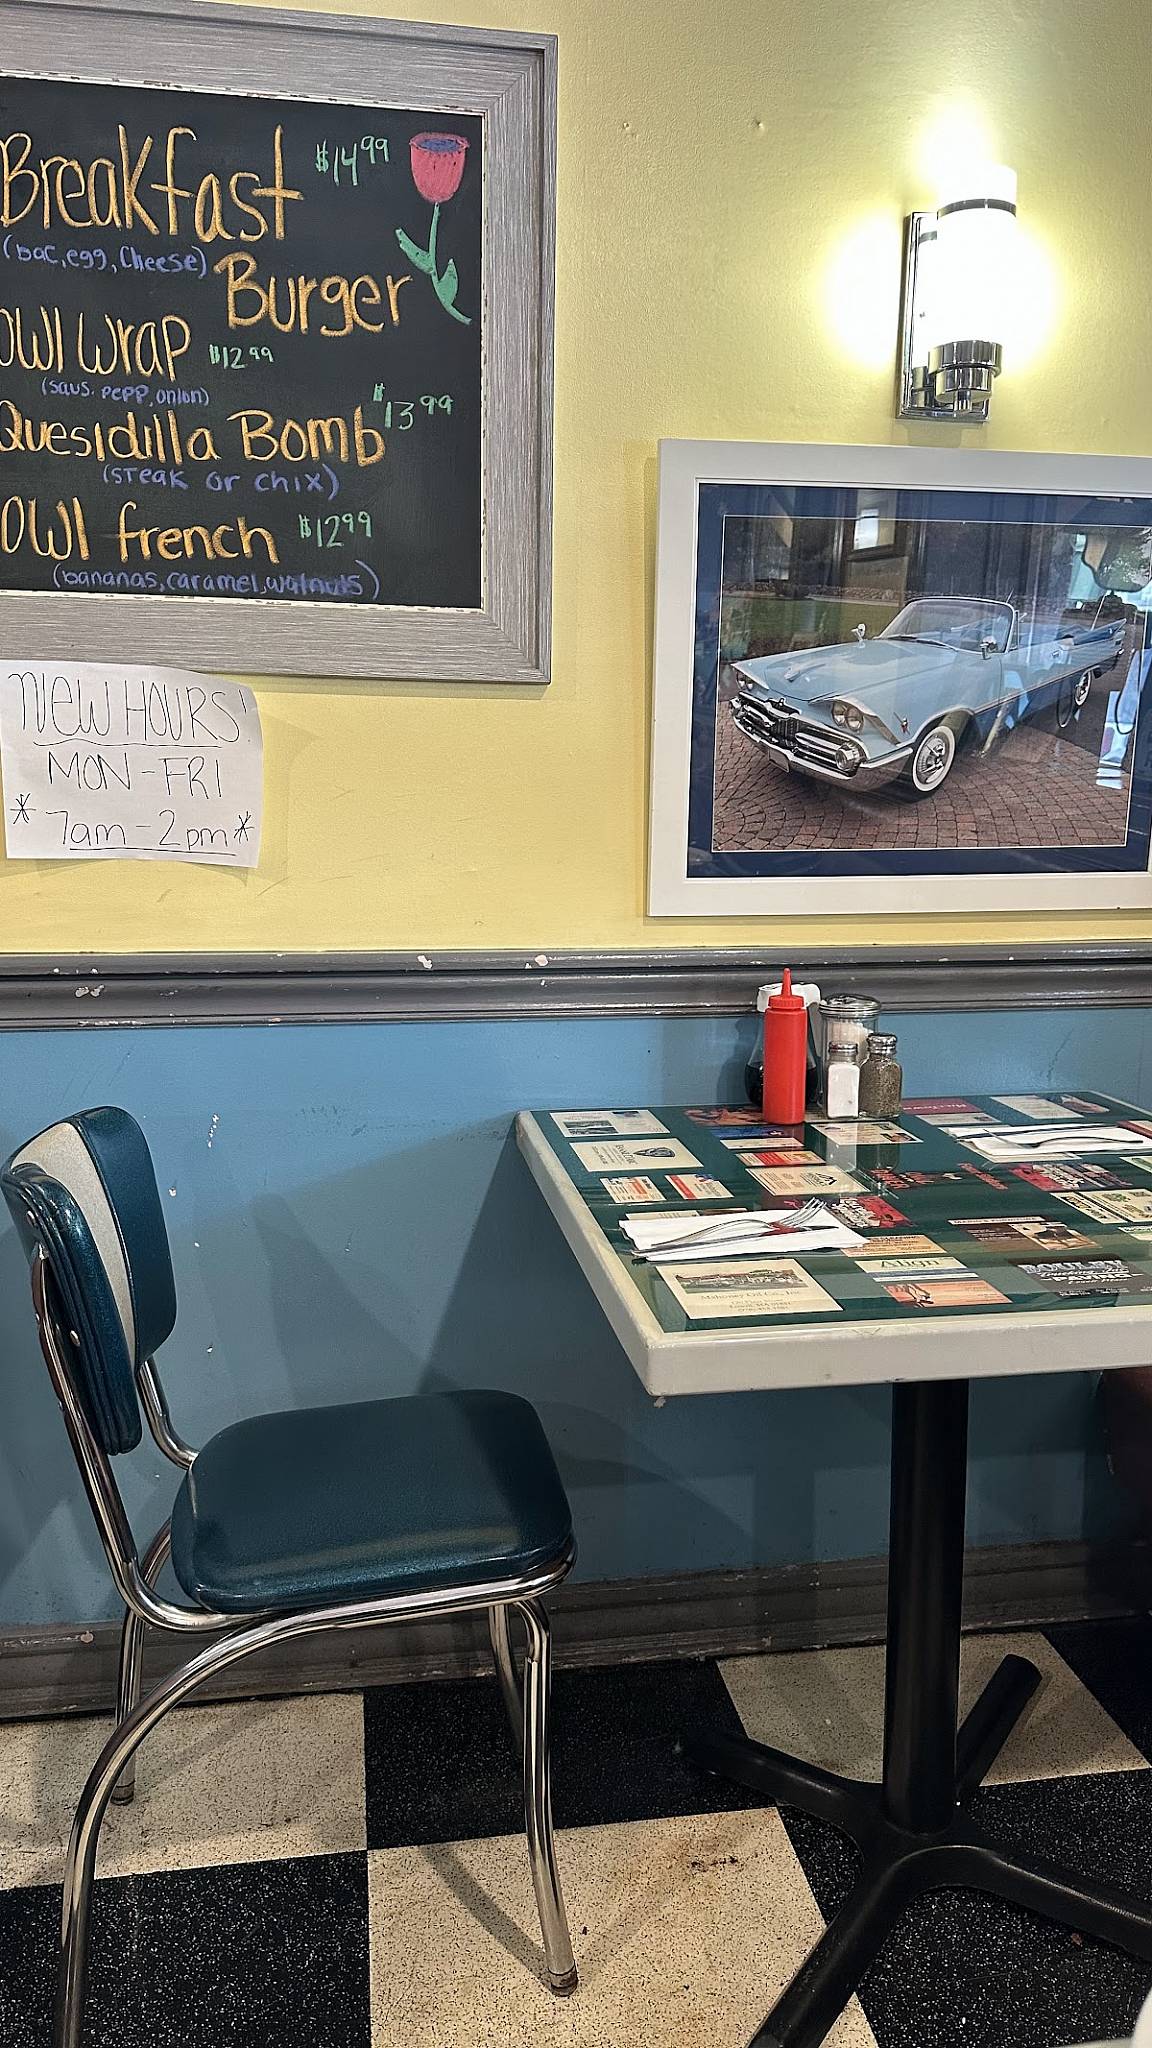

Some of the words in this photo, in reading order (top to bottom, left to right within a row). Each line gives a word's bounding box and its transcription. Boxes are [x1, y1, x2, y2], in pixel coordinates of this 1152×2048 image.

[0, 123, 304, 243] Breakfast
[213, 250, 413, 337] Burger
[0, 399, 221, 466] Quesidilla
[226, 405, 387, 467] Bomb
[205, 470, 239, 493] or
[117, 500, 281, 565] french
[880, 1258, 940, 1268] Align
